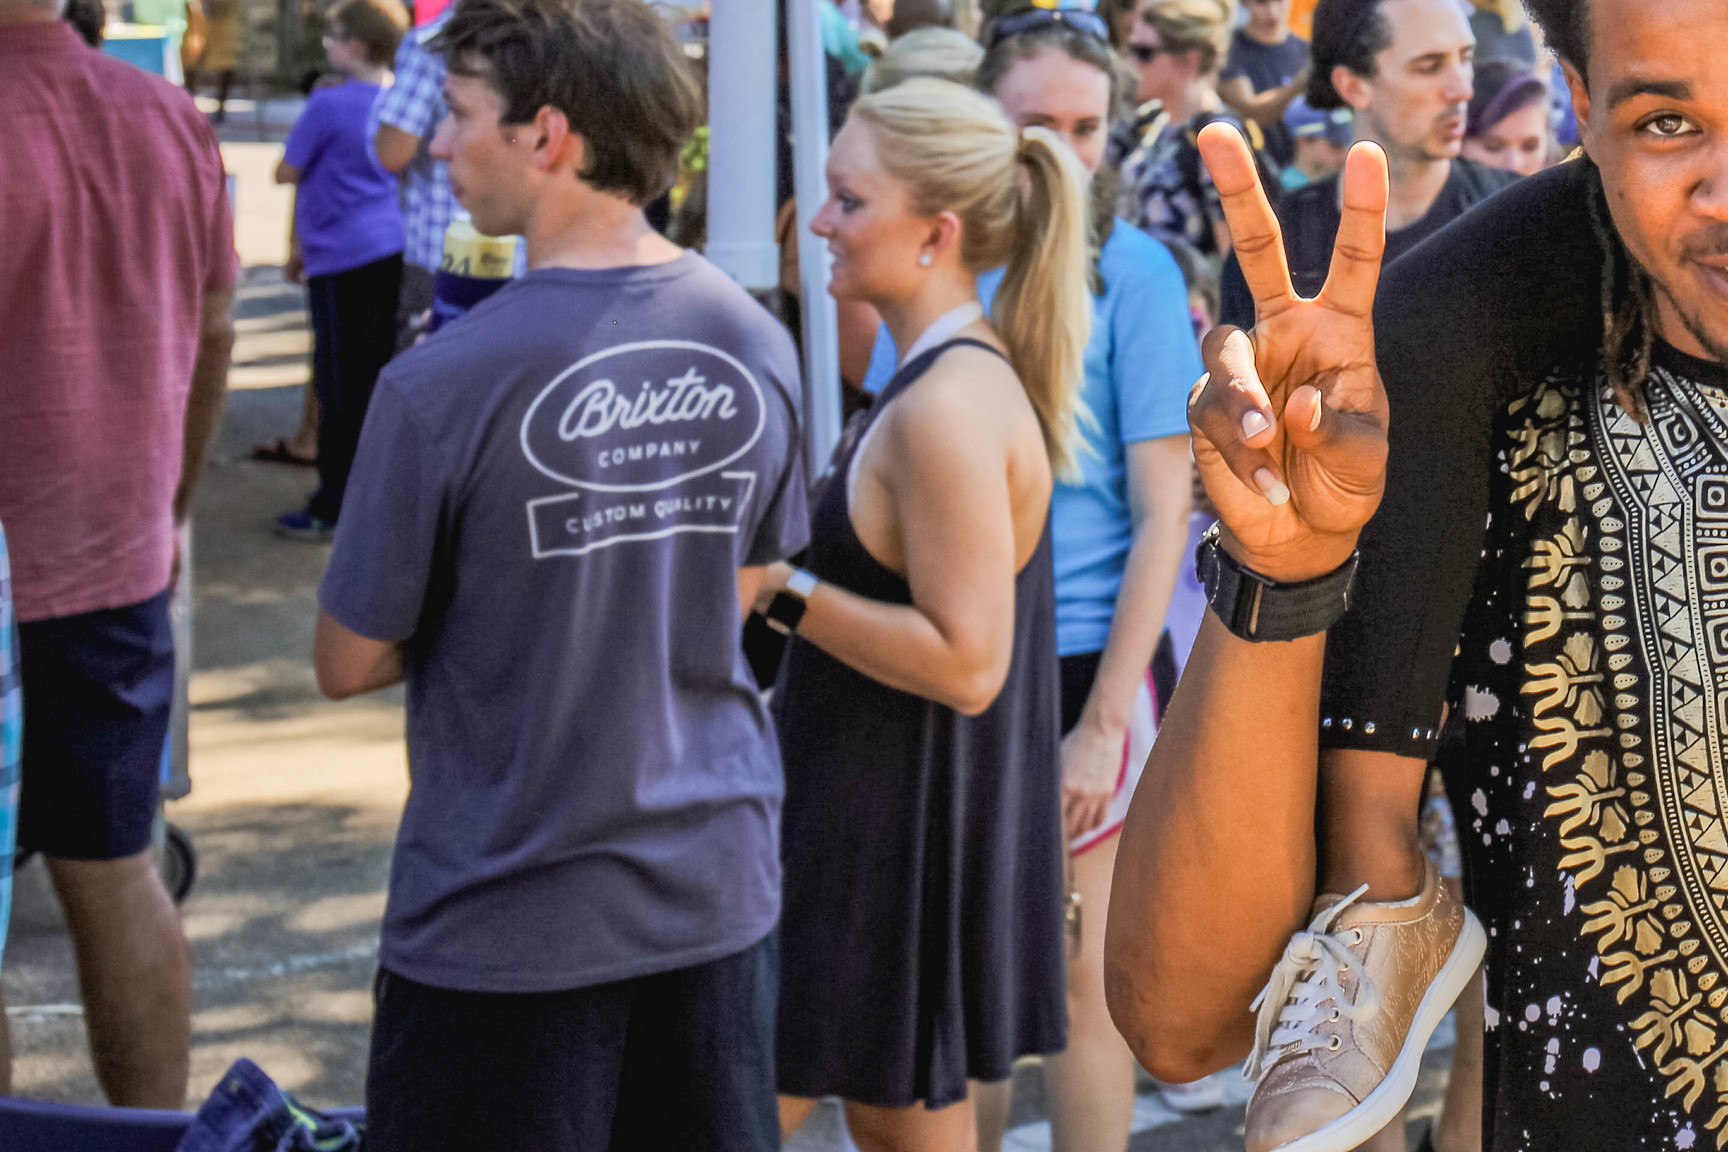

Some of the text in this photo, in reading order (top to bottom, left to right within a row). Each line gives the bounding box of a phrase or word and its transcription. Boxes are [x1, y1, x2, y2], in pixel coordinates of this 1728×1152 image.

[558, 367, 738, 441] Brixton
[598, 440, 701, 468] COMPANY
[565, 498, 732, 534] CUSTOM QUALITY
